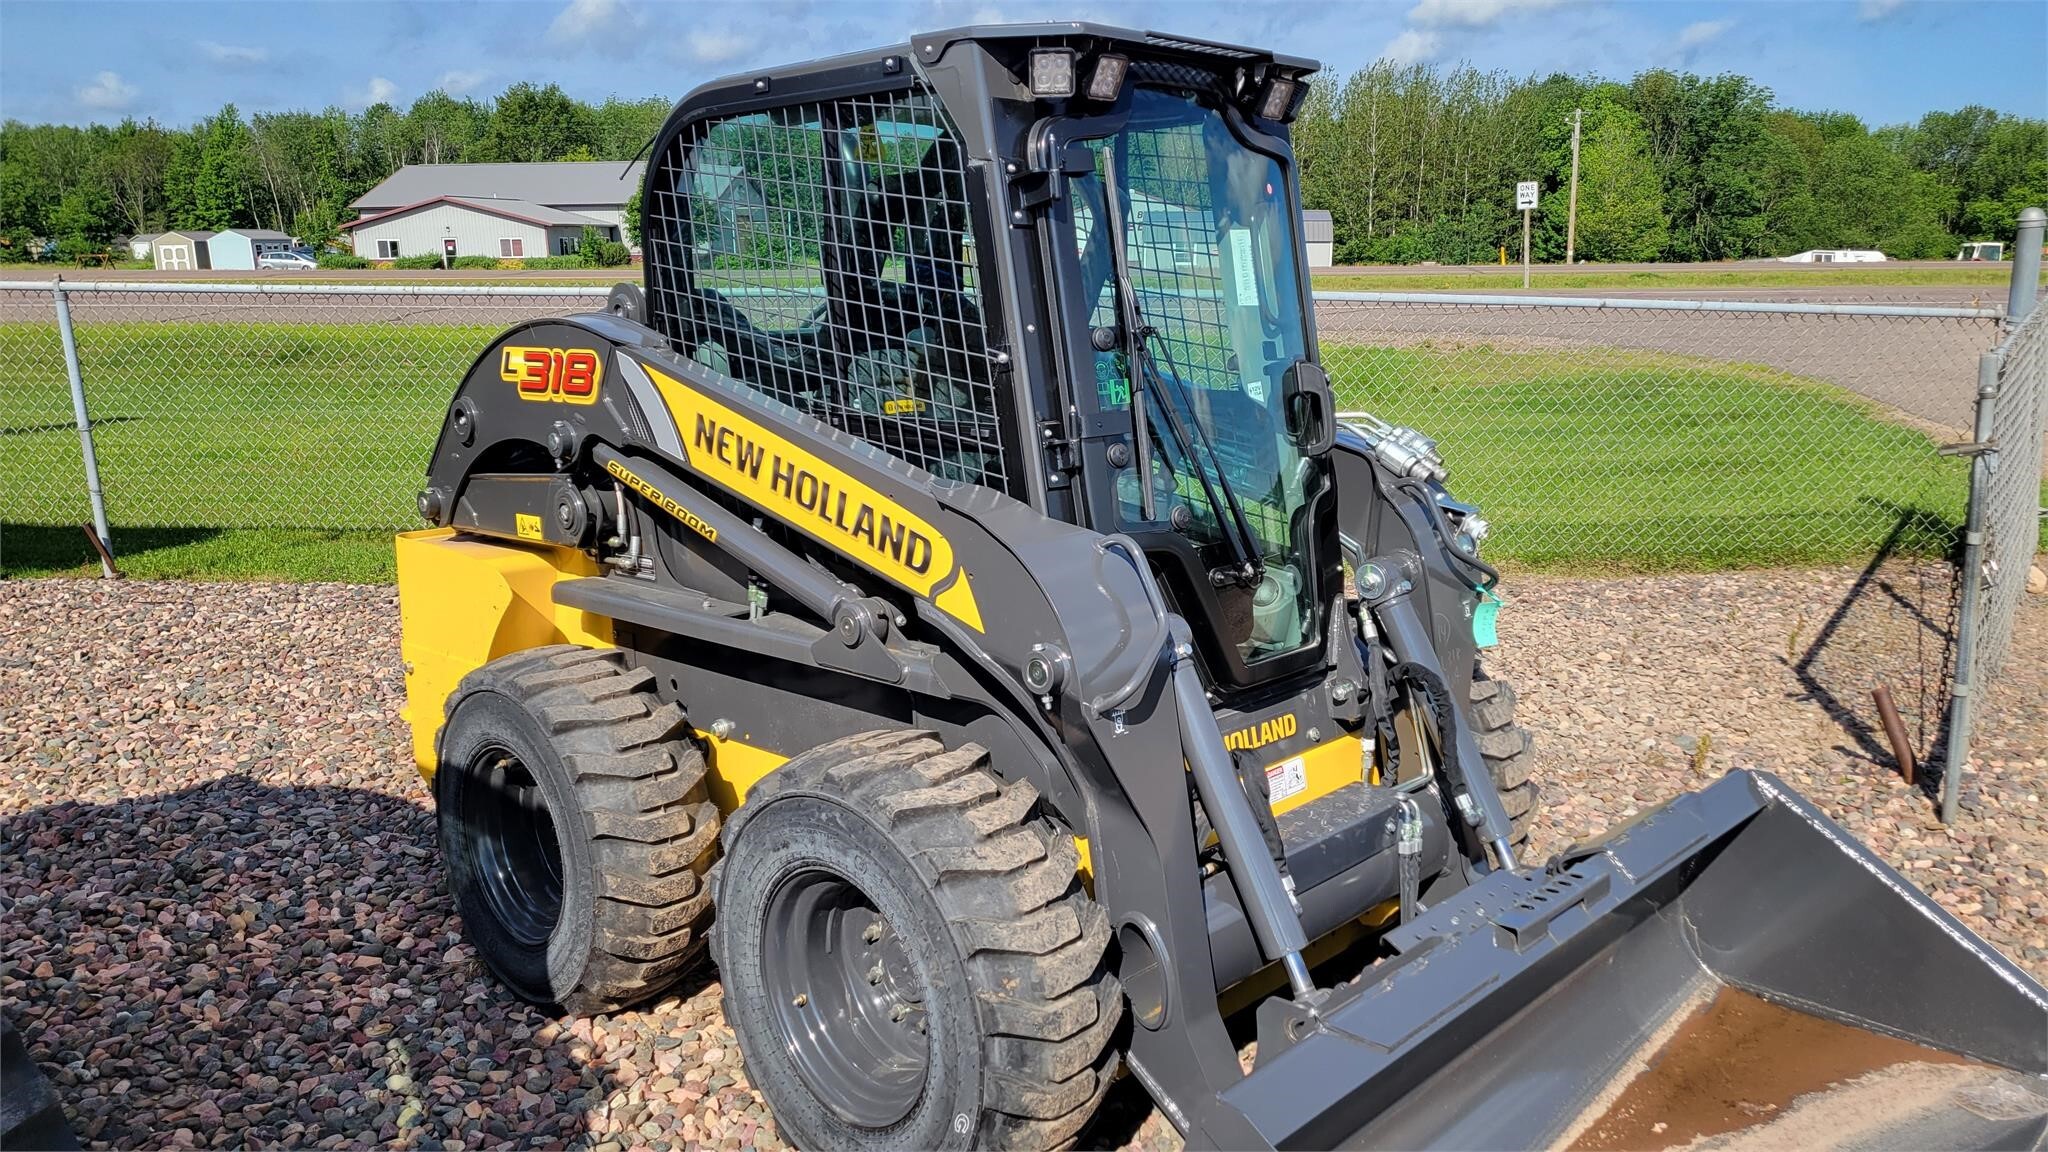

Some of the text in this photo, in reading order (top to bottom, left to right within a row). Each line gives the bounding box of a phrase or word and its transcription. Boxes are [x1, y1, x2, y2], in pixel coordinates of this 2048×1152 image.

[503, 351, 597, 396] L318
[609, 463, 715, 539] SUPER BOOM
[694, 413, 932, 575] NEW HOLLAND
